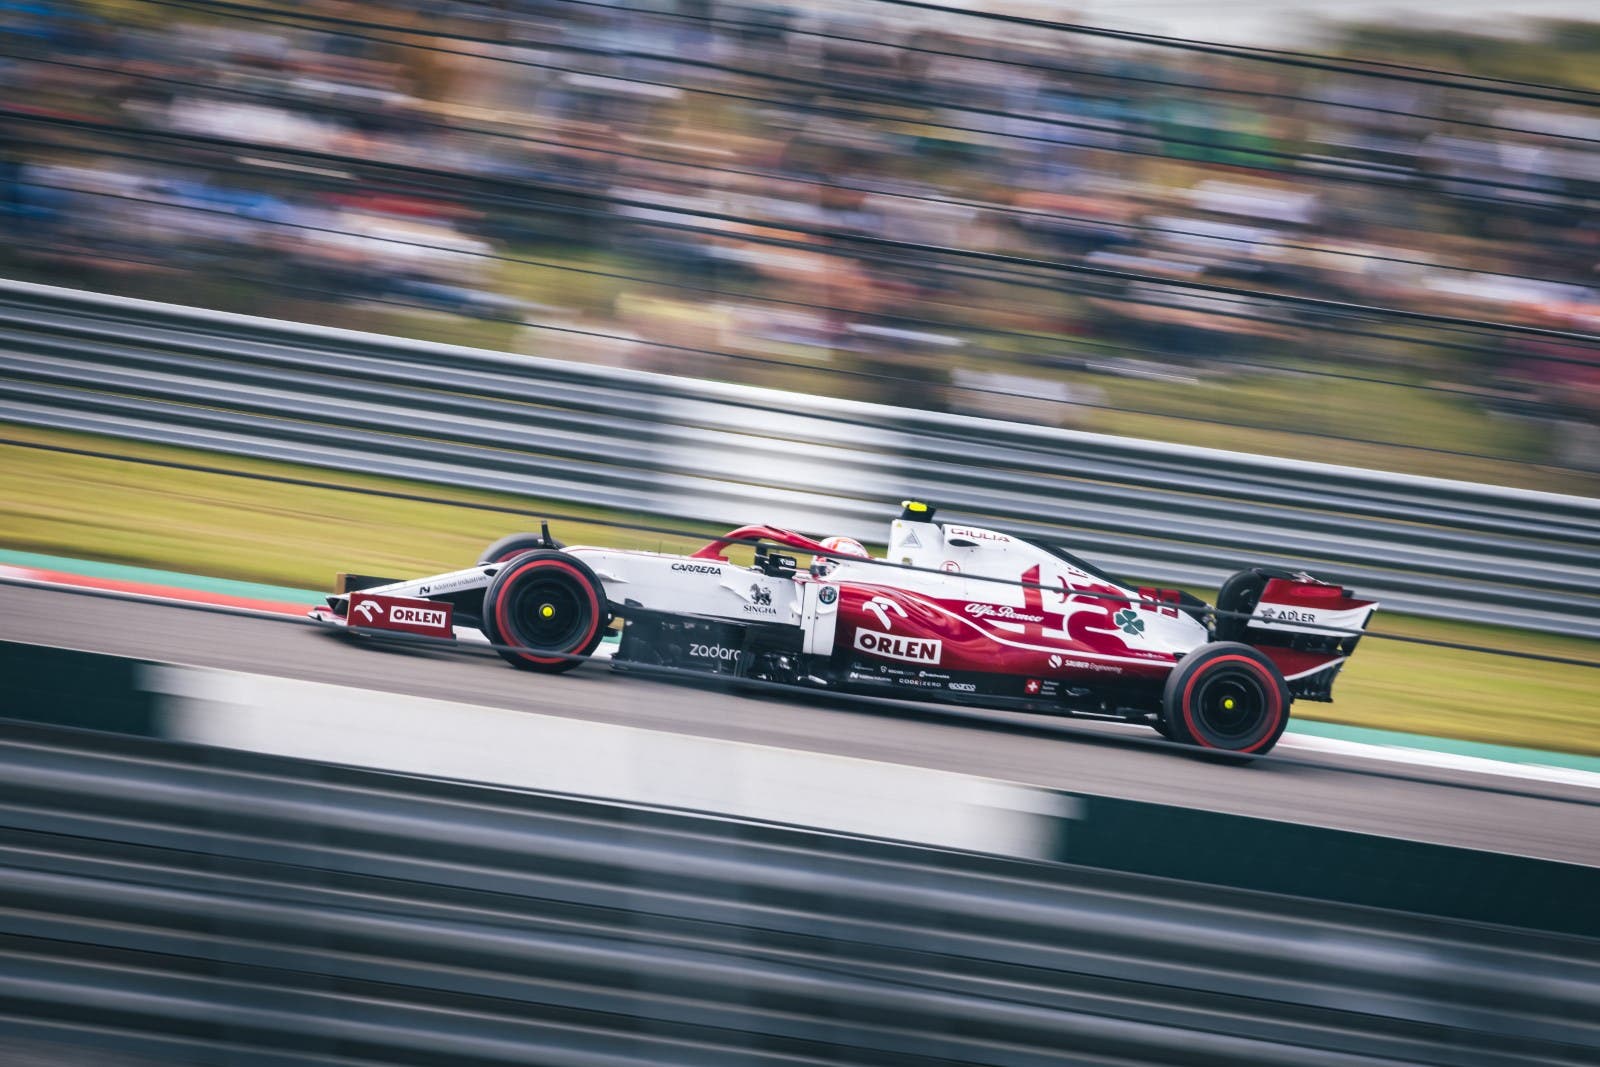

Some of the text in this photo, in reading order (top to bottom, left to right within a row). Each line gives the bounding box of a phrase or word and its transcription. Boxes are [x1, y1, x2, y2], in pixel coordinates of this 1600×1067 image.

[951, 528, 1010, 542] GIULIA
[671, 563, 722, 575] CARRERA
[743, 604, 777, 615] SINGHA
[964, 603, 1044, 622] Alfa Romeo
[1278, 610, 1315, 623] ADLER
[393, 609, 444, 625] ORLEN
[859, 633, 937, 661] ORLEN
